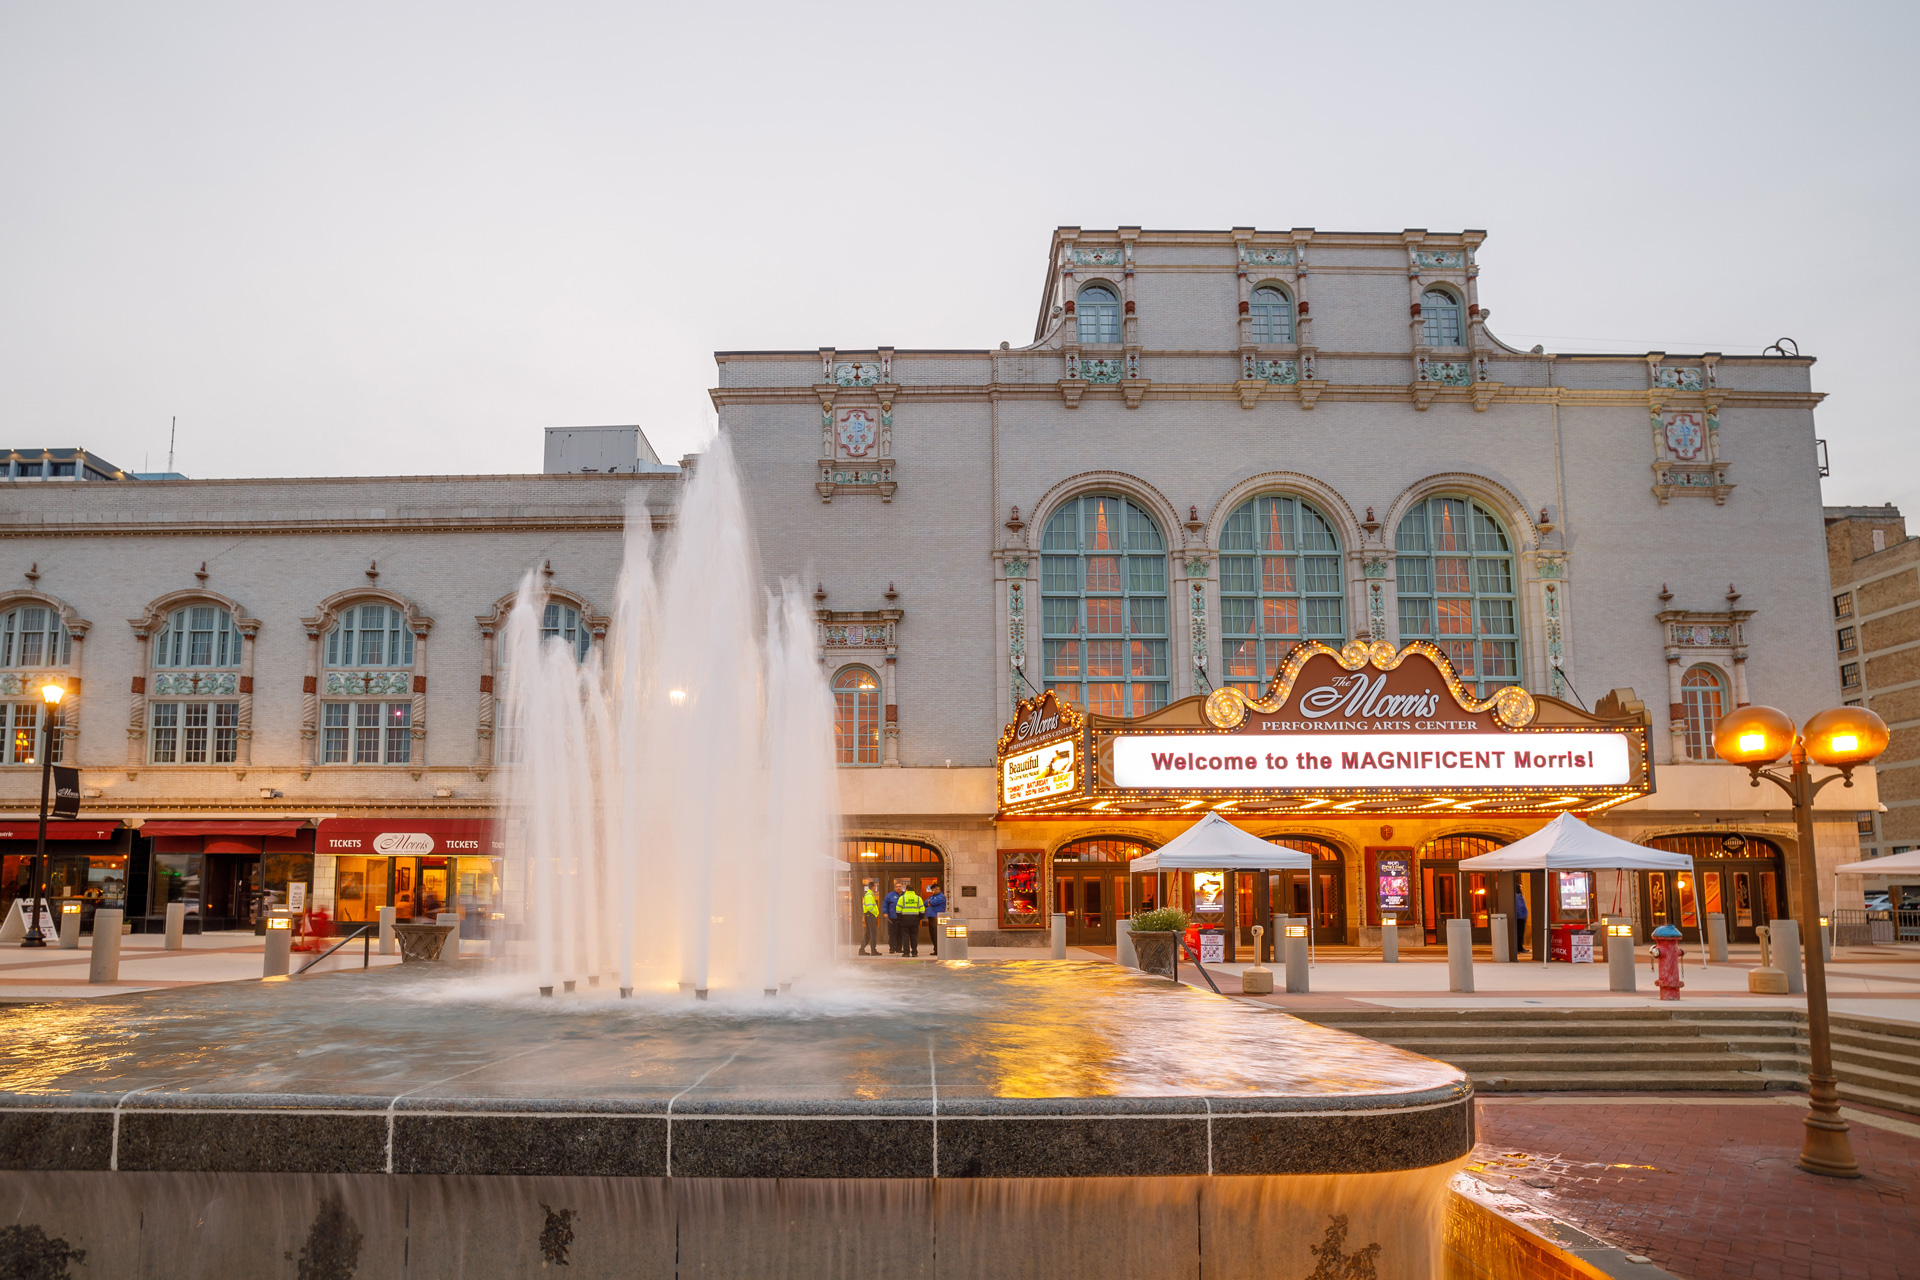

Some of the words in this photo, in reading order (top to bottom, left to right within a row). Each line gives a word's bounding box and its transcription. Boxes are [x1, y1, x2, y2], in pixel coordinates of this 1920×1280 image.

[1331, 676, 1352, 687] The
[1300, 673, 1439, 718] Morris
[1017, 708, 1060, 741] Morris
[1261, 721, 1369, 731] PERFORMING
[1372, 721, 1411, 731] ARTS
[1414, 720, 1479, 731] CENTER
[1008, 737, 1039, 751] PERFORMING
[1039, 733, 1052, 742] ARTS
[1051, 726, 1074, 738] CENTER
[1008, 755, 1039, 775] Beautiful
[1151, 752, 1258, 770] Welcome
[1265, 753, 1288, 770] to
[1296, 752, 1332, 770] the
[1341, 751, 1505, 770] MAGNIFICENT
[1514, 751, 1594, 769] Morris!
[329, 839, 362, 848] TICKETS
[380, 834, 429, 850] Morris
[446, 840, 479, 849] TICKETS
